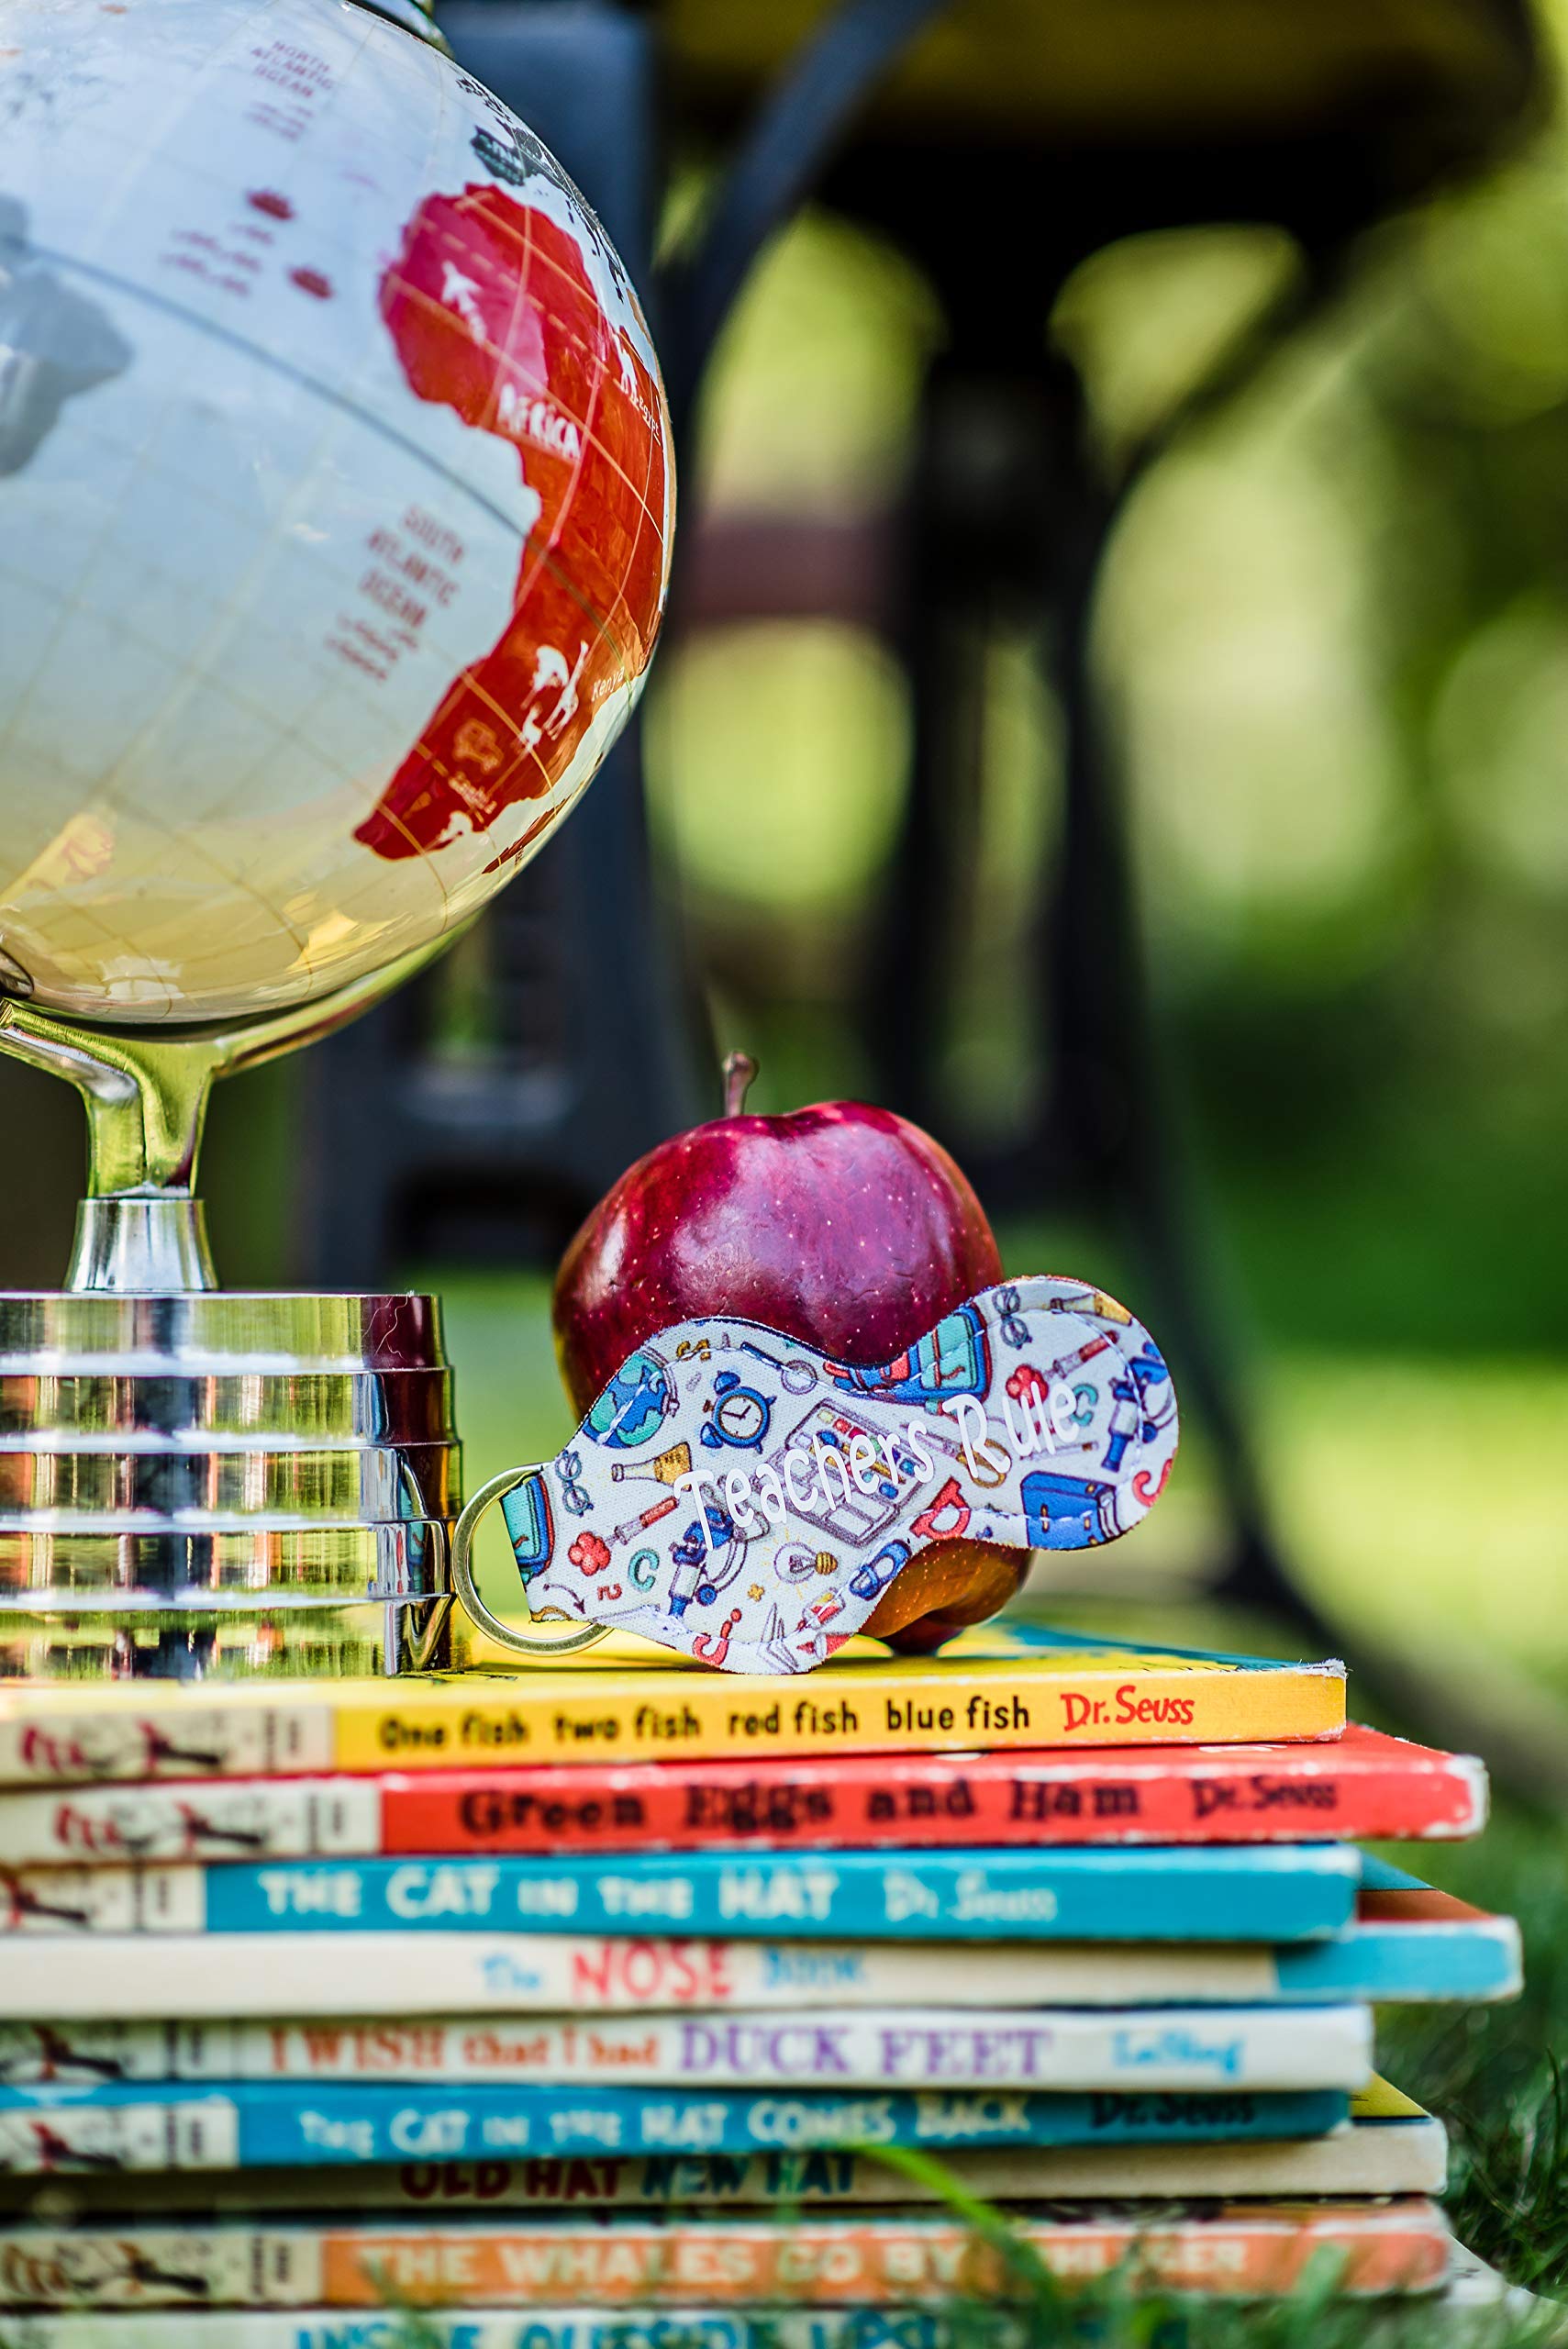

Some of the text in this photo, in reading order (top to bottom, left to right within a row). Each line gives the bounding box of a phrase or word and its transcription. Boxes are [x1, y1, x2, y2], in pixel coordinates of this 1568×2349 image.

[591, 666, 625, 703] Kenya
[674, 1380, 1081, 1551] Teachers Rule
[380, 1715, 446, 1750] One
[462, 1710, 528, 1744] fish
[555, 1714, 619, 1742] two
[635, 1705, 700, 1739] fish
[728, 1703, 781, 1737] red
[795, 1700, 858, 1734] fish
[887, 1699, 954, 1731] blue
[967, 1696, 1030, 1729] fish
[1116, 1685, 1195, 1726] Seuss
[462, 1789, 646, 1837] Green
[684, 1781, 834, 1832] Eggs
[867, 1778, 975, 1821] and
[1013, 1780, 1140, 1821] Ham
[257, 1868, 362, 1918] THE
[386, 1864, 500, 1920] CAT
[597, 1876, 695, 1920] THE
[719, 1866, 840, 1921] HAT
[571, 1939, 732, 2003] NOSE
[271, 2025, 288, 2072] I
[301, 2025, 447, 2071] WISH
[463, 2032, 549, 2067] that
[585, 2034, 658, 2068] had
[681, 2023, 850, 2076] DUCK
[878, 2028, 1049, 2078] FEET
[389, 2108, 470, 2155] CAT
[642, 2101, 728, 2153] HAT
[748, 2099, 897, 2146] COMES
[915, 2095, 1031, 2138] BACK
[400, 2154, 856, 2200] OLD HAT NEW HAT
[355, 2241, 971, 2285] THE WHALES GO BY
